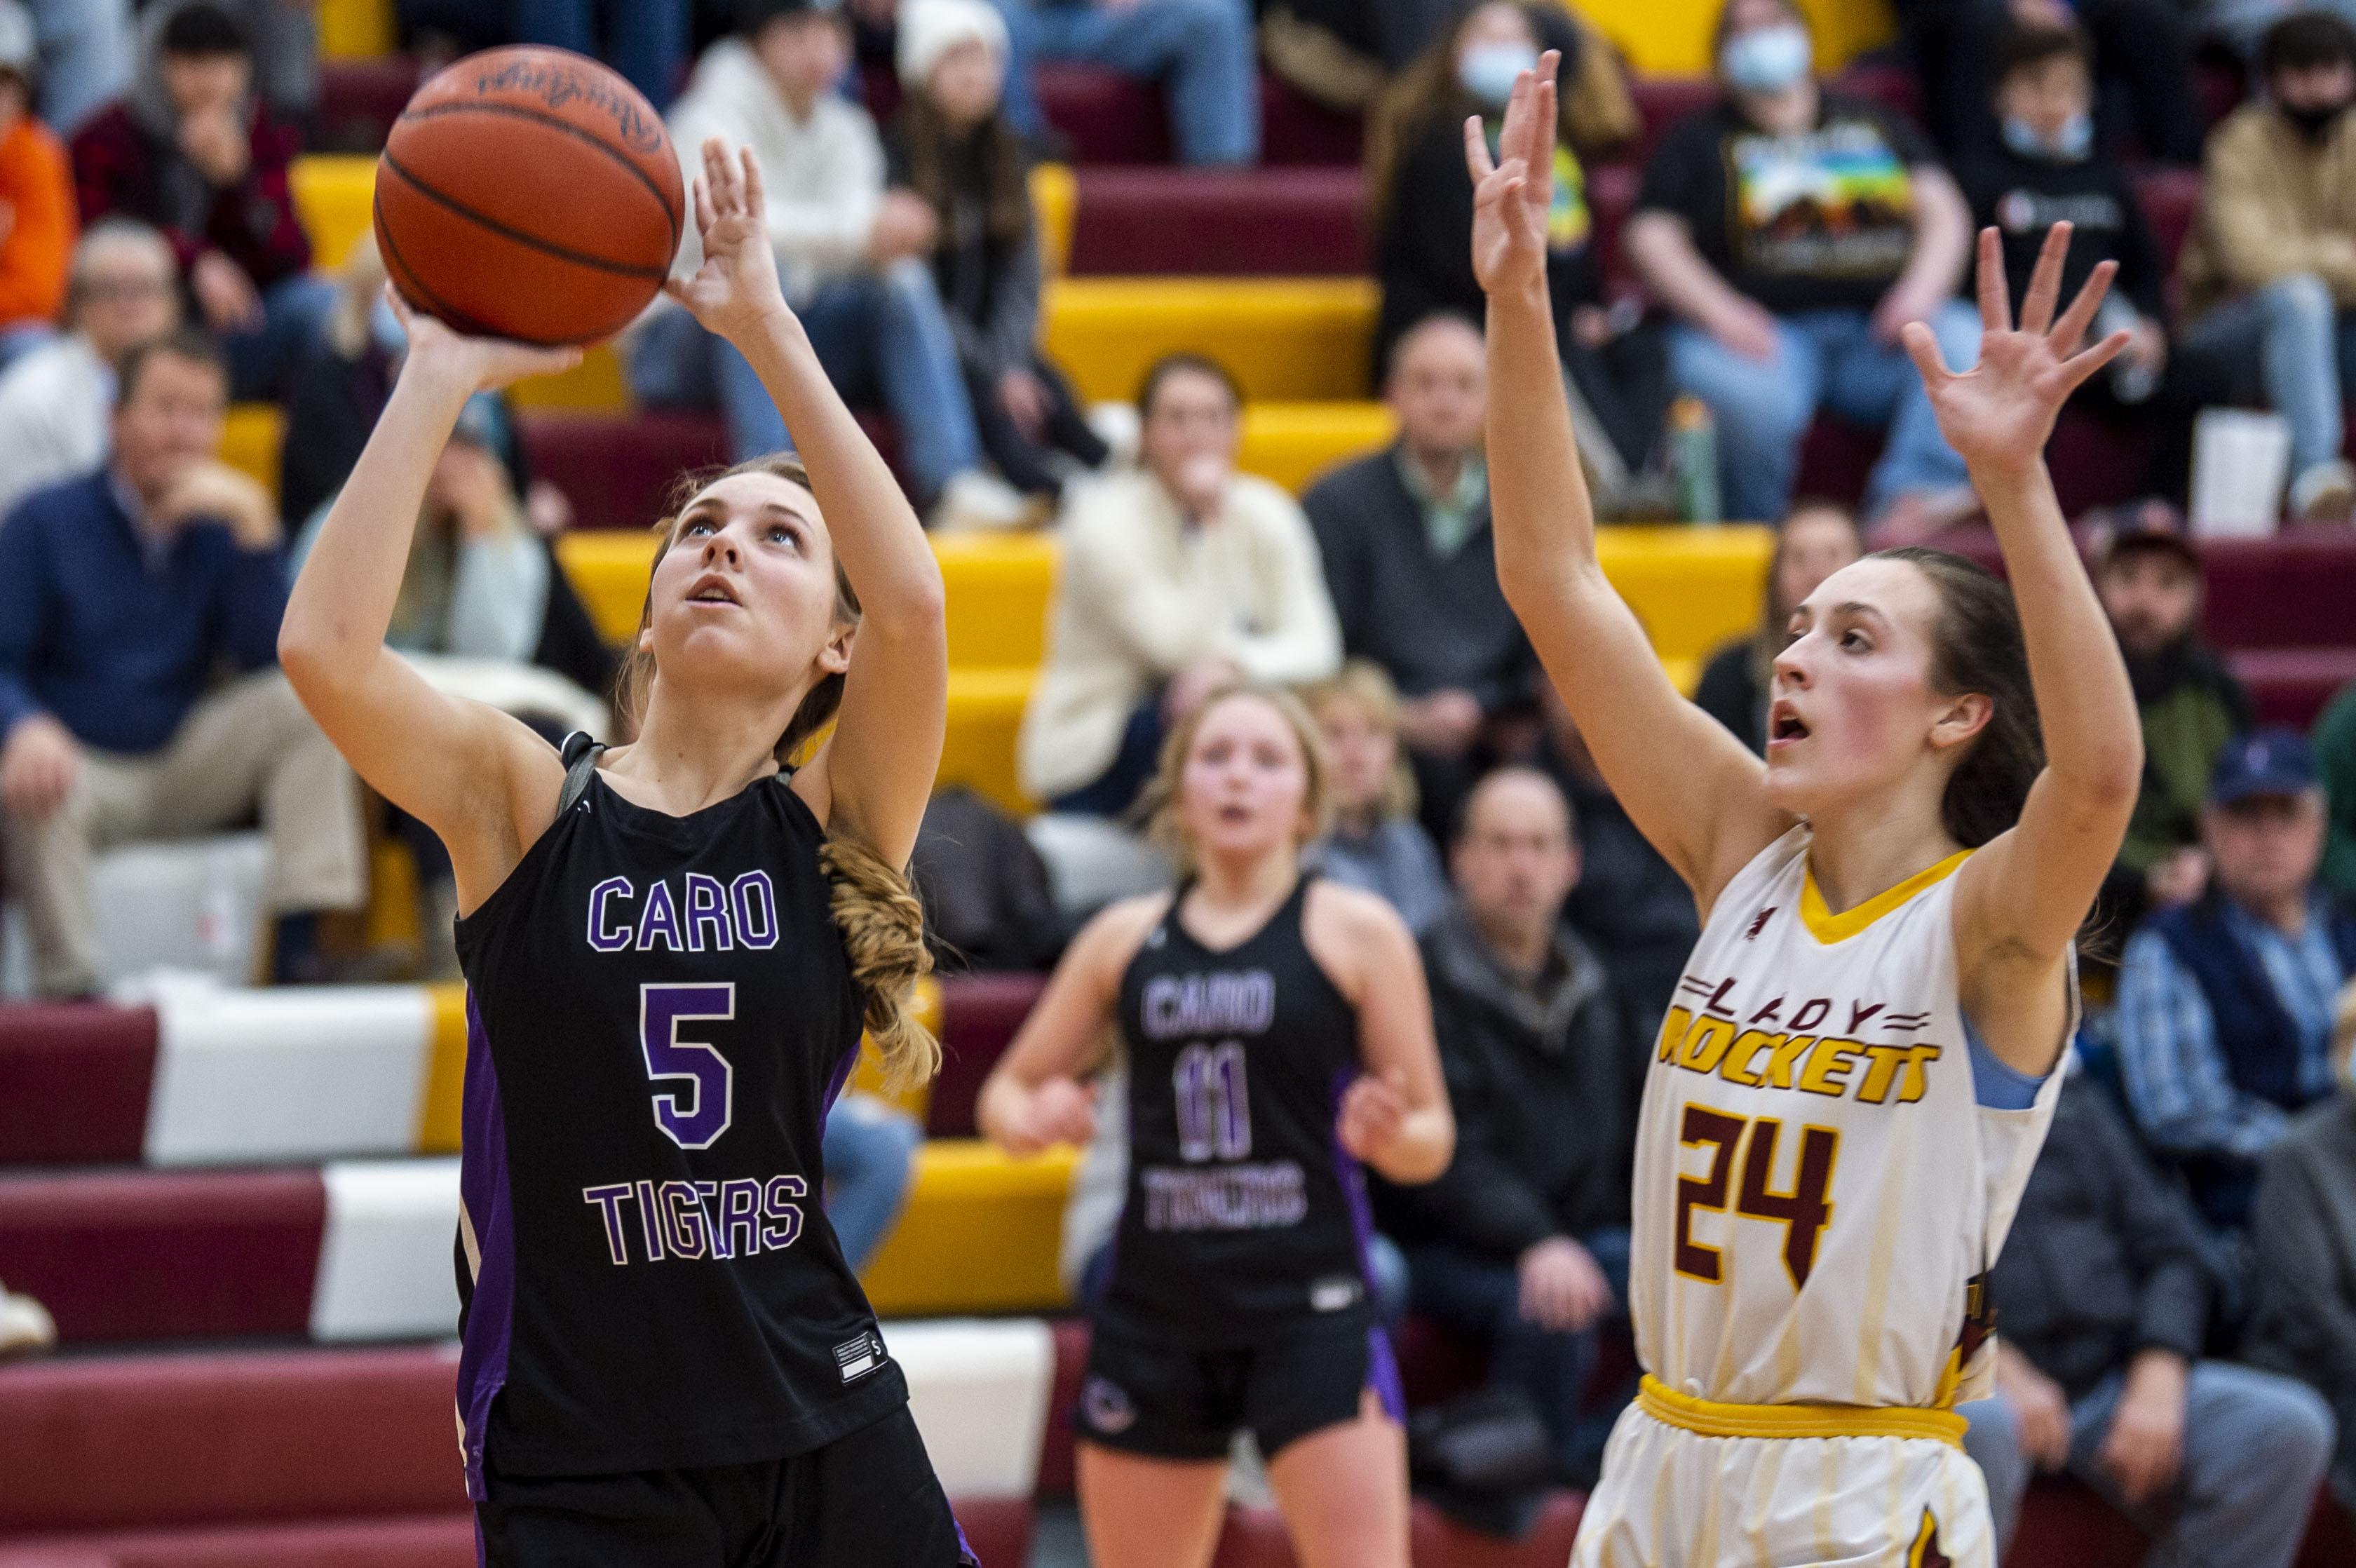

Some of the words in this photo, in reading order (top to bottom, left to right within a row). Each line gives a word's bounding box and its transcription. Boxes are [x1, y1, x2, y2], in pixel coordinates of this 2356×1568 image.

[587, 870, 779, 952] CARO
[1706, 976, 1886, 1034] LADY
[639, 982, 735, 1150] 5
[1172, 1040, 1251, 1161] 11
[1674, 1102, 1841, 1295] 24
